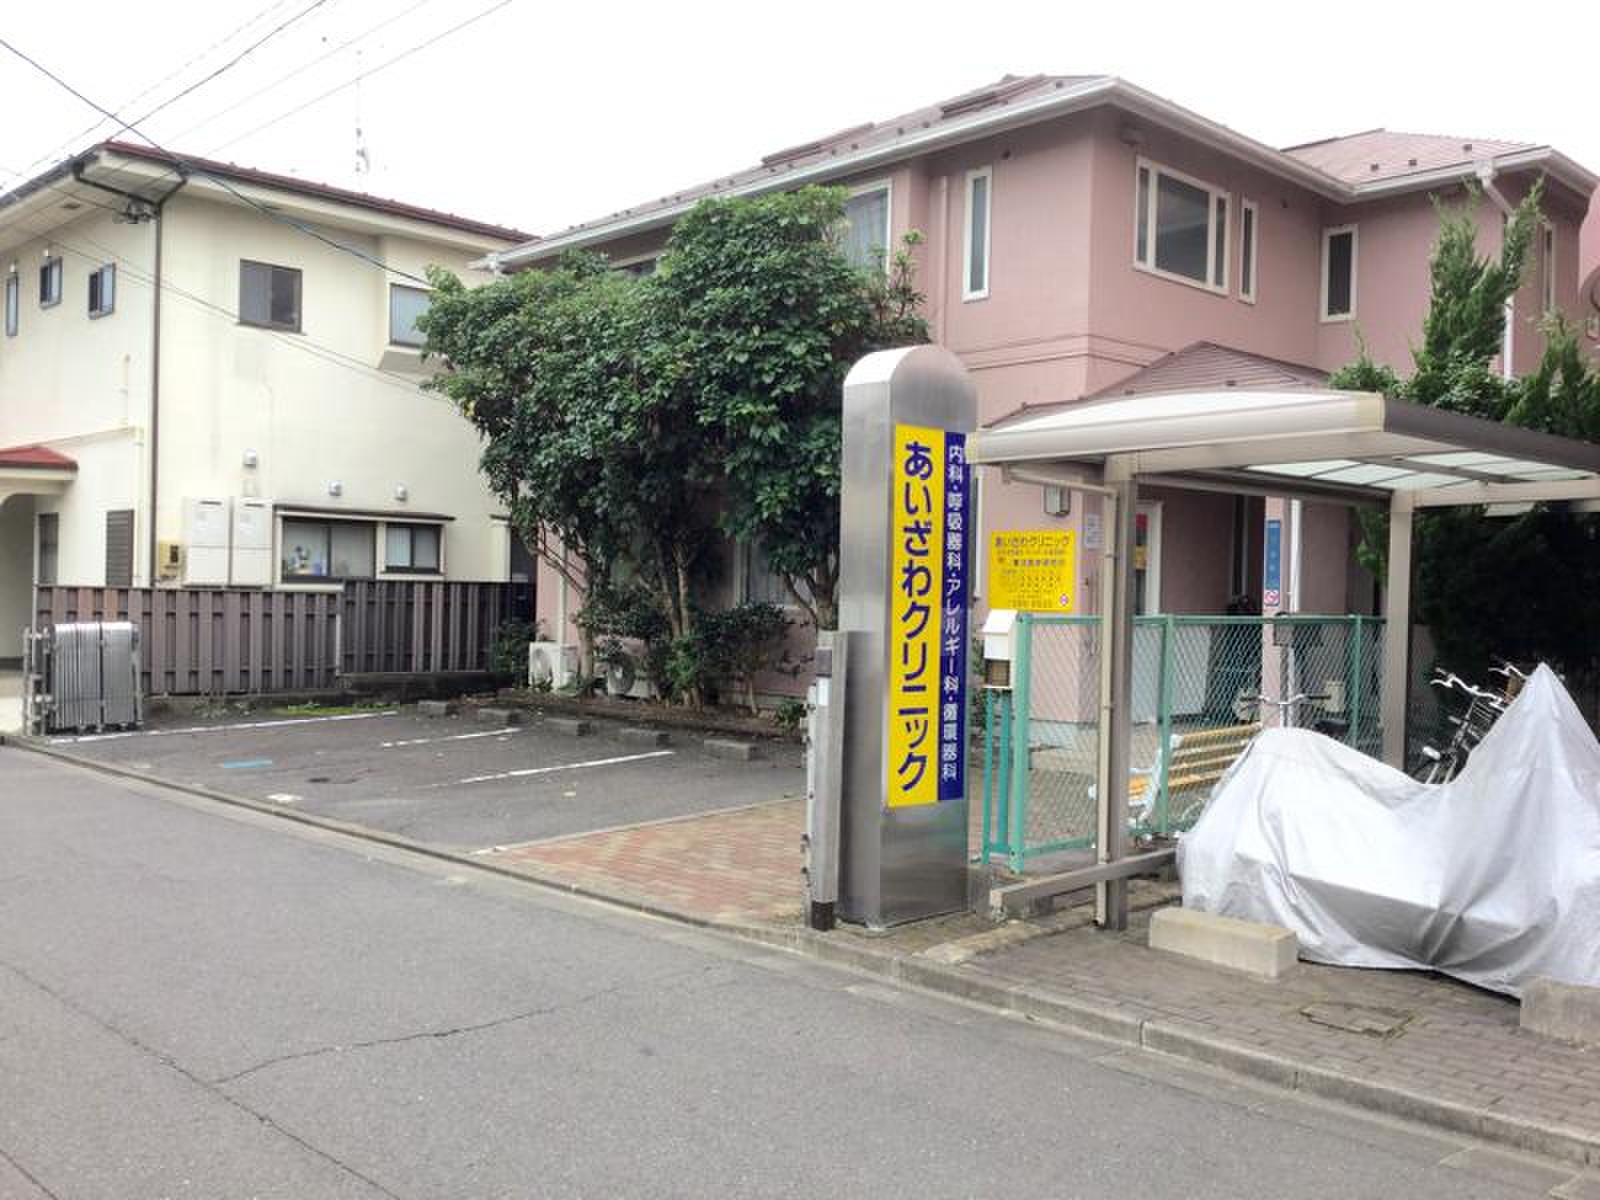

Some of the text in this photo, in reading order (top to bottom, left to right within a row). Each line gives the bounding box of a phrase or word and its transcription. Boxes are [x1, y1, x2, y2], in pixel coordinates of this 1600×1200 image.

[897, 441, 933, 791] あいざわクリニック
